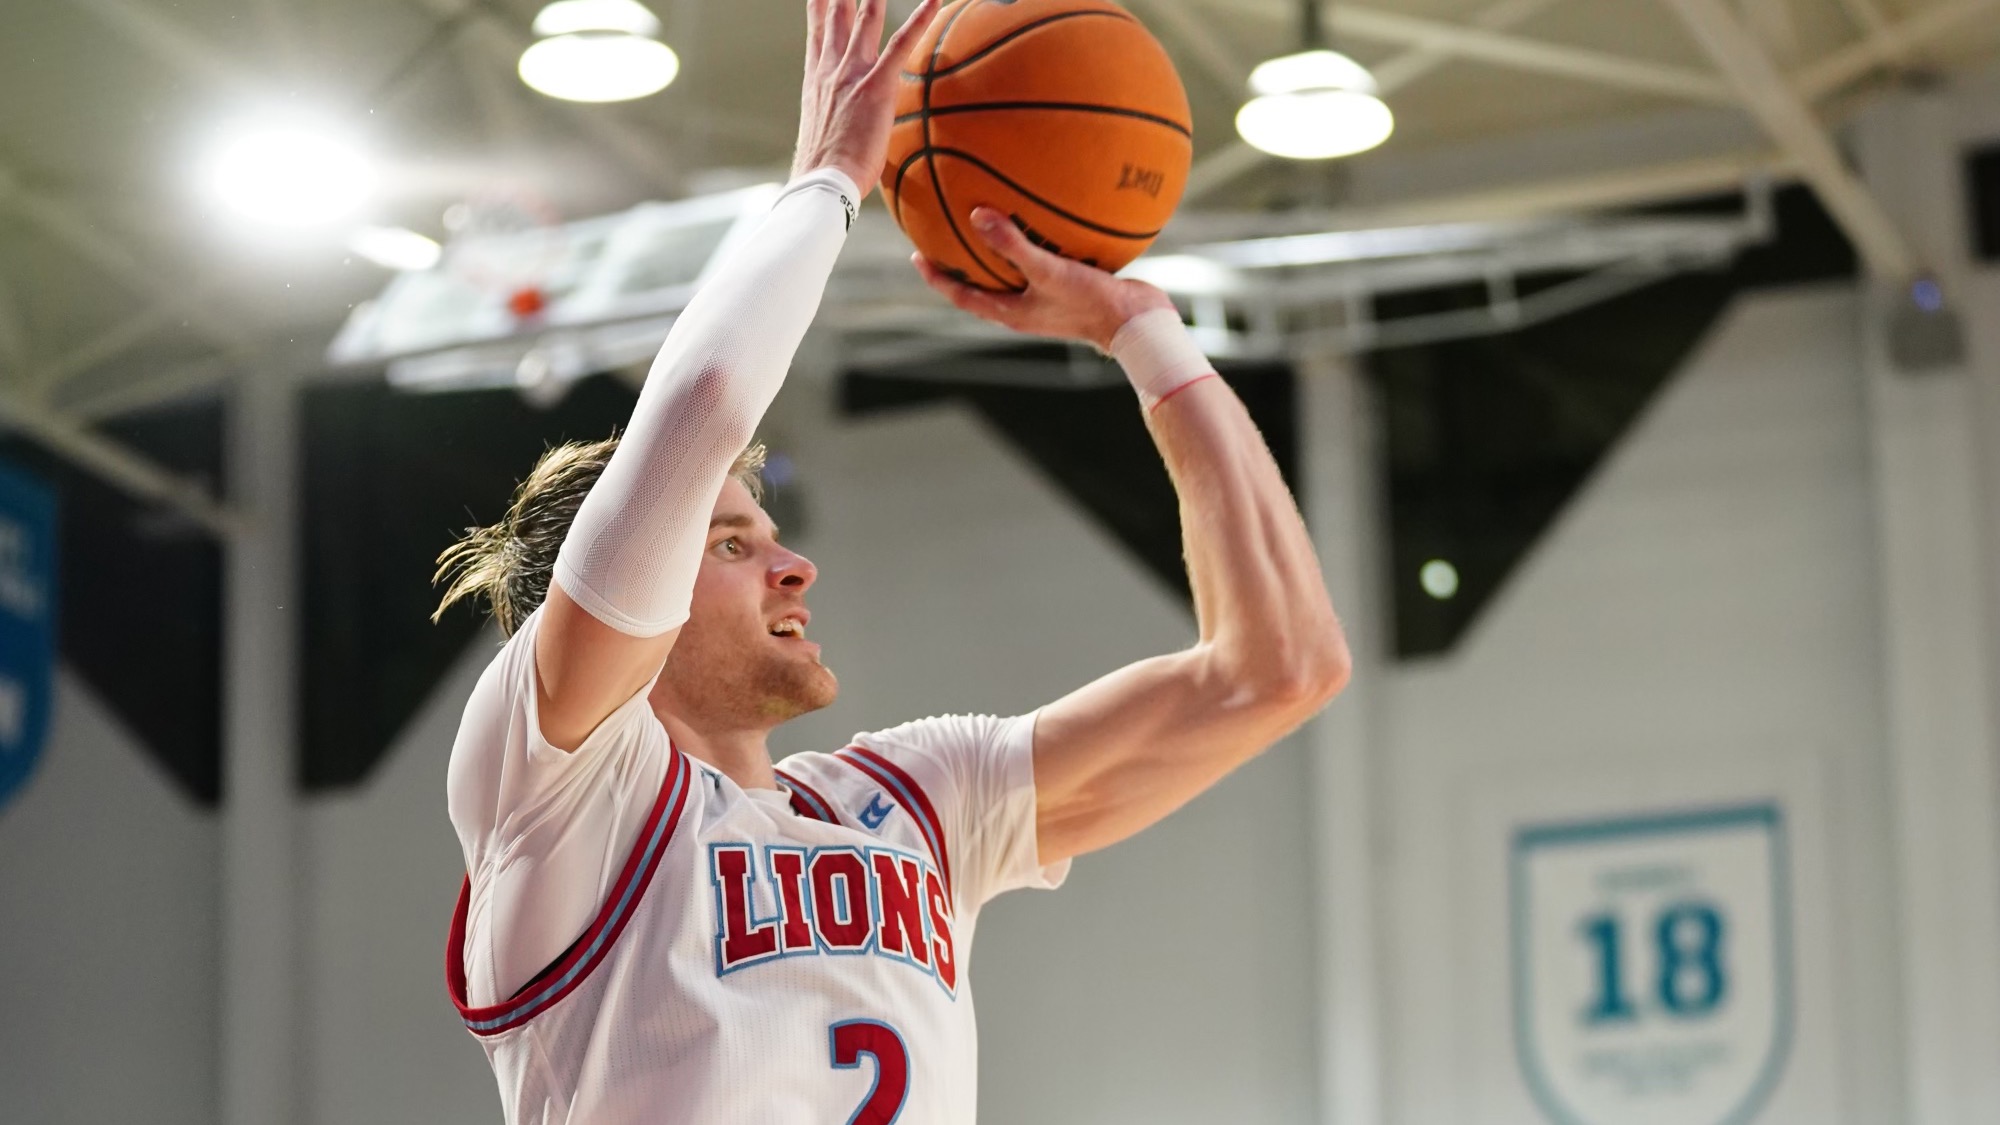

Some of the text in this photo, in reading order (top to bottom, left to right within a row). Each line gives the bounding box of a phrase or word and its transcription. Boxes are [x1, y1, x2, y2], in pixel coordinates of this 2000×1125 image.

[1116, 163, 1164, 199] LMU
[709, 843, 957, 1001] LIONS
[1577, 901, 1727, 1026] 18
[829, 1018, 911, 1125] 2
